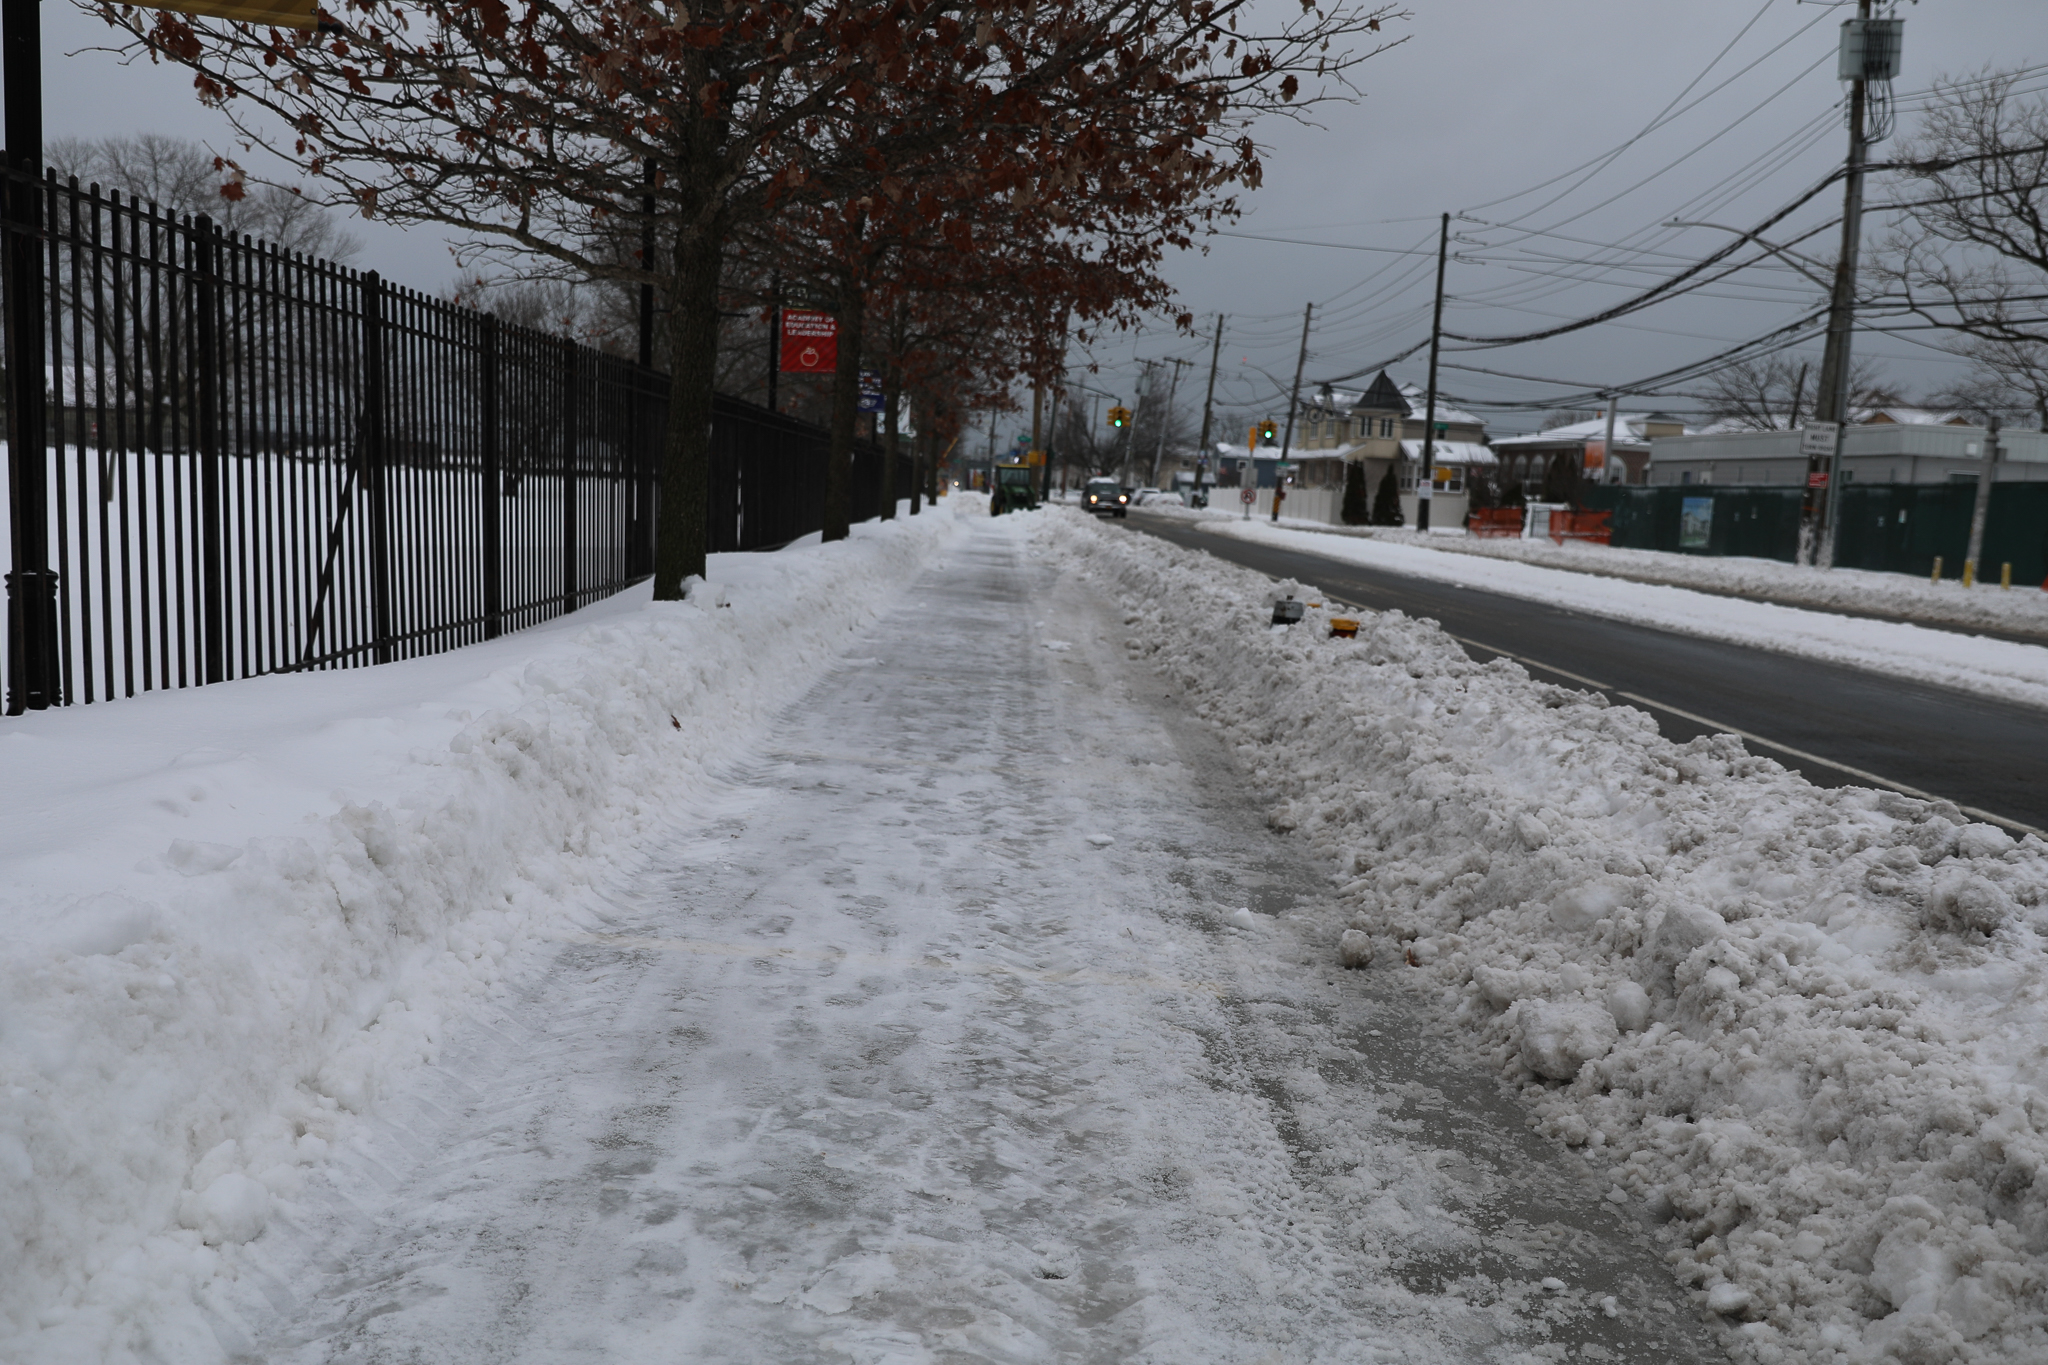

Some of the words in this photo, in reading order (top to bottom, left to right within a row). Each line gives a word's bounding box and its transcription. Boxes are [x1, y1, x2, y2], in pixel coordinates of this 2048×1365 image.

[787, 314, 823, 323] ACADEMY
[785, 322, 829, 330] EDUCATION
[787, 329, 834, 337] LEADERSHIP
[1809, 434, 1829, 442] MUST
